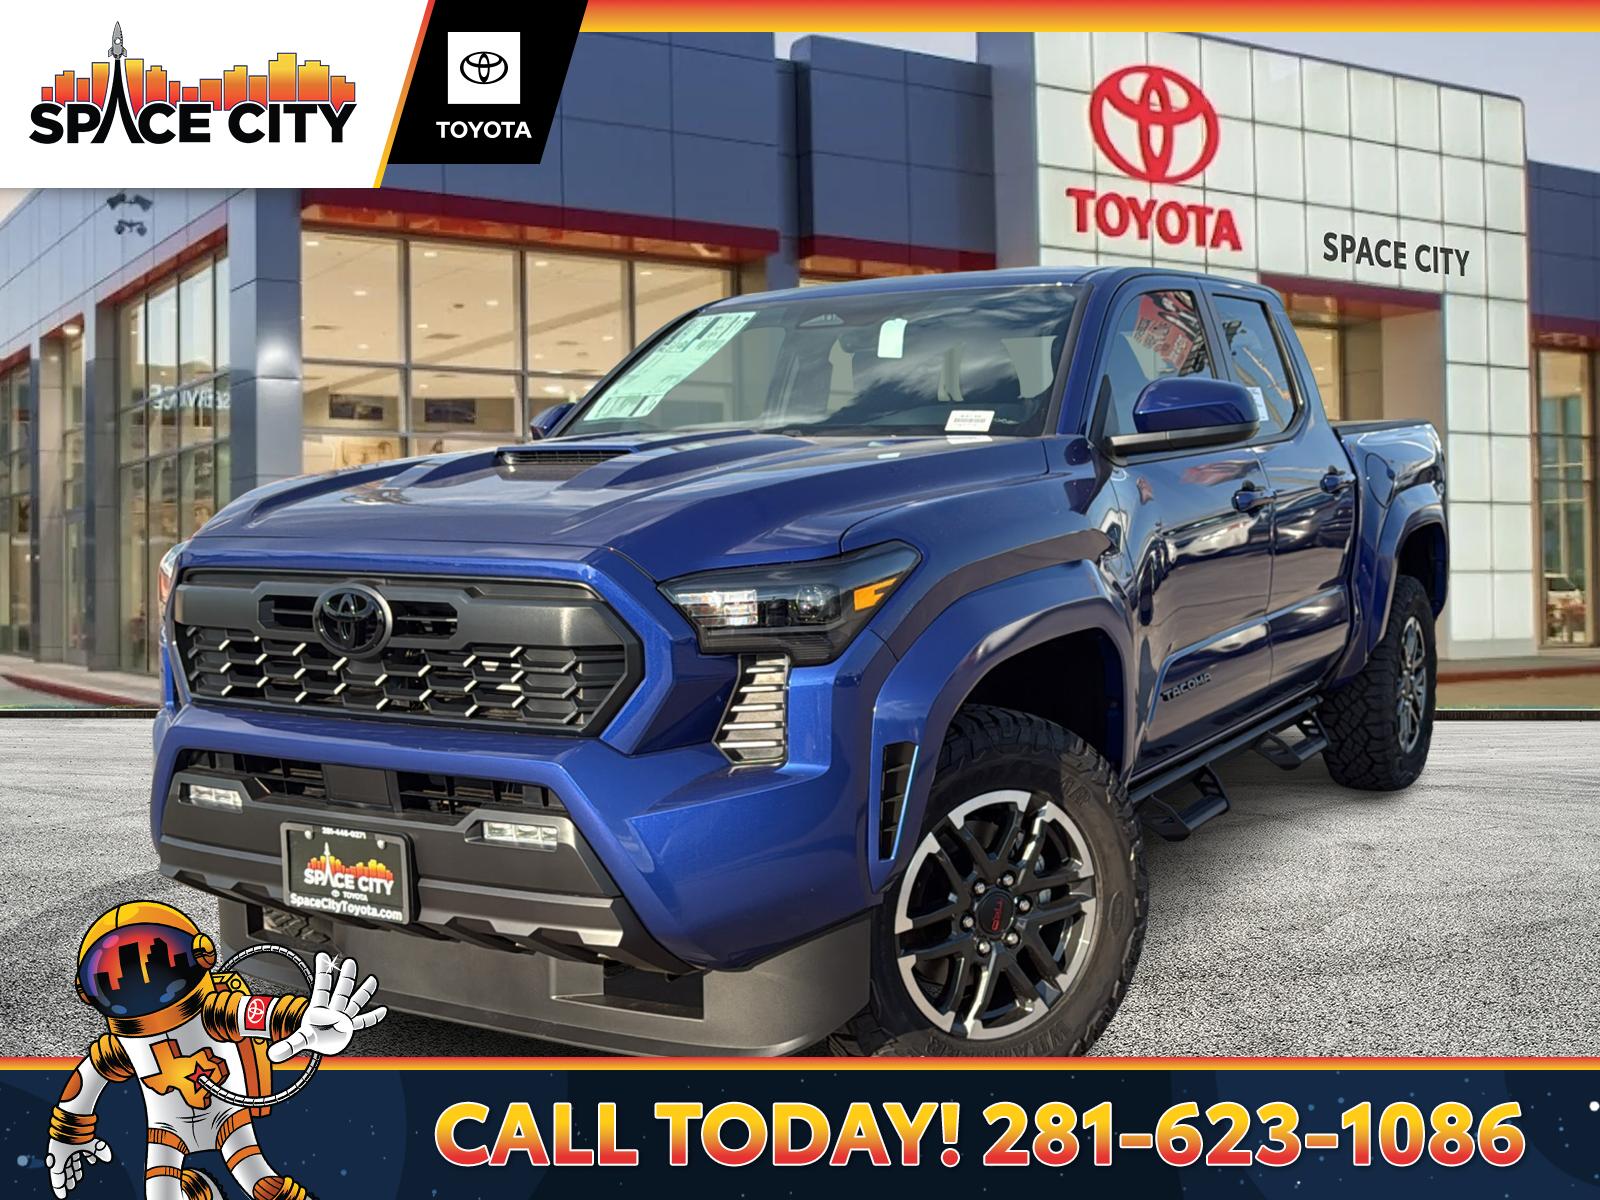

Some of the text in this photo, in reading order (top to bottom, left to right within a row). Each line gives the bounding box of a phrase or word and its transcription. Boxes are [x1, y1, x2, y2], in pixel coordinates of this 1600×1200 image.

[1066, 187, 1243, 252] TOYOTA
[1323, 232, 1471, 277] SPACE CITY
[1161, 673, 1212, 701] TACOMA
[304, 868, 394, 896] SPACE CITY
[290, 893, 402, 921] SpaceCityToyota.com
[342, 891, 369, 902] TOYOTA
